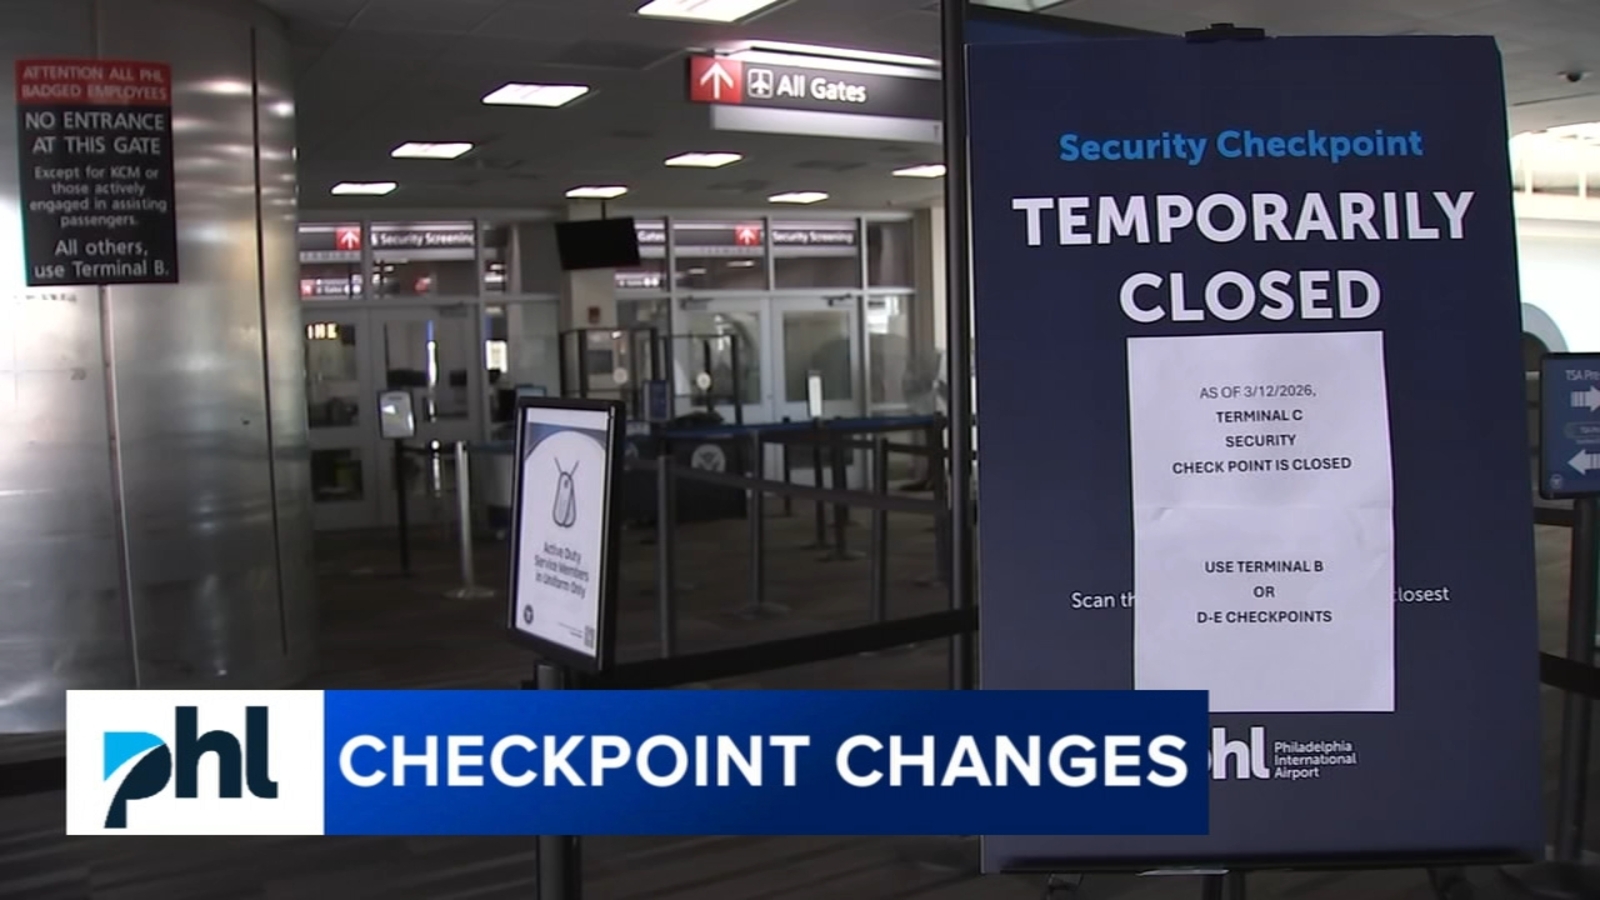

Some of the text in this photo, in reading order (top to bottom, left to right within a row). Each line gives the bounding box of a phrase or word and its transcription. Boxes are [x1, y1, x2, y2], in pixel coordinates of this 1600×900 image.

[23, 65, 164, 83] ATTENTION ALL PHL
[22, 84, 166, 100] BADGED EMPLOYEES
[776, 74, 866, 103] All Gates
[25, 111, 165, 130] NO ENTRANCE
[32, 136, 161, 155] AT THIS GATE
[1059, 129, 1423, 166] Security Checkpoint
[34, 165, 159, 181] Except for KCM or
[51, 182, 146, 197] those actively
[29, 198, 167, 213] engaged in assisting
[1012, 190, 1475, 246] TEMPORARILY
[381, 232, 422, 247] Security
[773, 231, 853, 245] Security Screening
[54, 238, 148, 257] All others,
[34, 259, 169, 278] use Terminal B.
[1119, 269, 1381, 324] CLOSED
[1565, 370, 1582, 380] TSA
[1200, 384, 1316, 399] AS OF 3/12/2026,
[1216, 409, 1303, 423] TERMINAL C
[1225, 434, 1296, 448] SECURITY
[1172, 457, 1351, 475] CHECK POINT IS CLOSED
[565, 547, 581, 565] Duty
[535, 554, 588, 582] Service Members
[1205, 561, 1324, 573] USE TERMINAL B
[544, 573, 569, 591] Uniform
[571, 581, 585, 599] Only
[1253, 586, 1275, 598] OR
[1394, 586, 1450, 602] losest
[1071, 591, 1116, 608] Scan
[1196, 610, 1332, 623] D-E CHECKPOINTS
[1209, 726, 1270, 780] hl
[1274, 740, 1352, 754] Philadelphia
[1274, 753, 1357, 766] International
[1274, 767, 1320, 780] Airport
